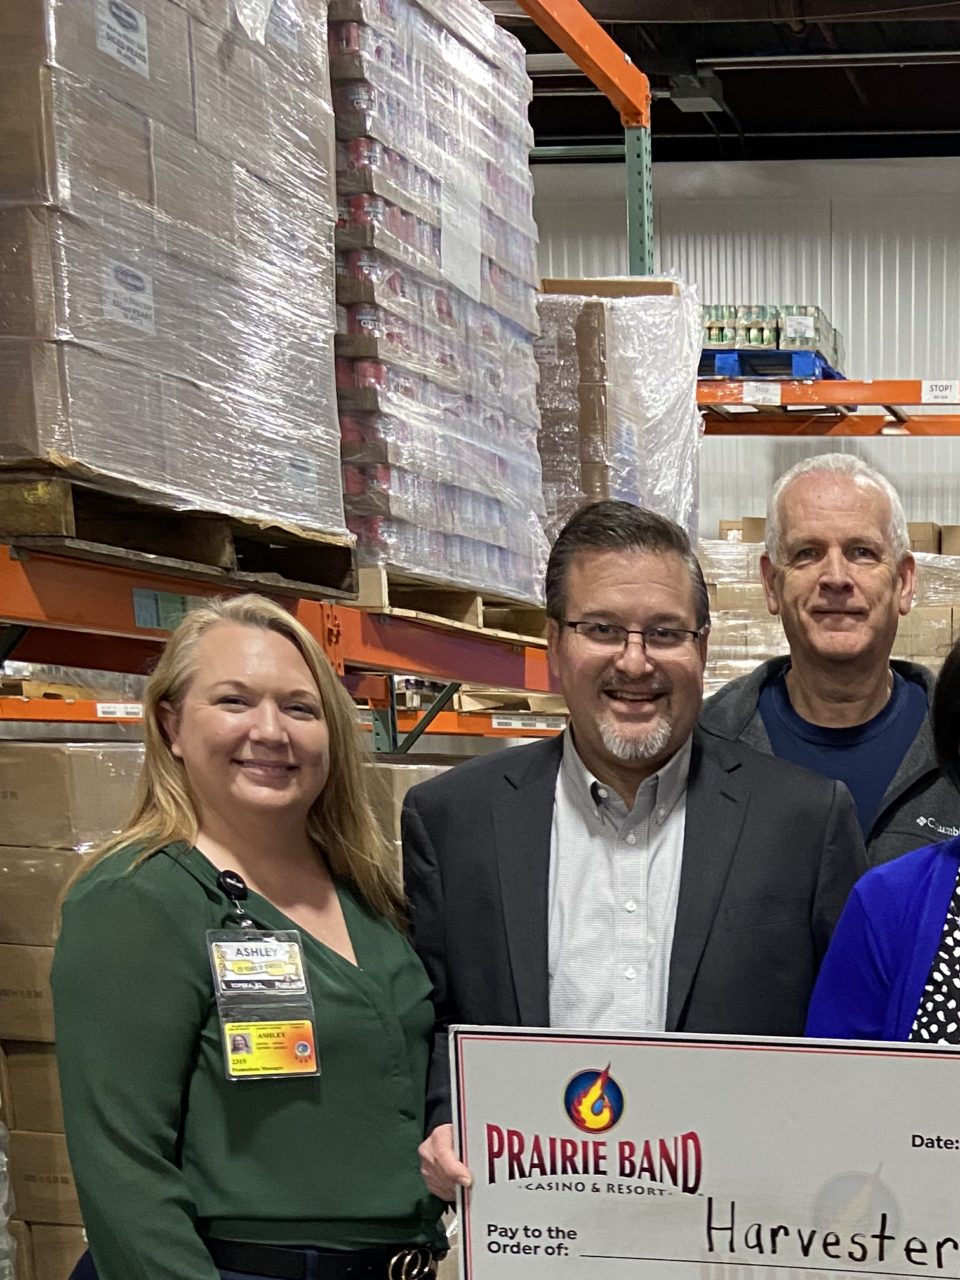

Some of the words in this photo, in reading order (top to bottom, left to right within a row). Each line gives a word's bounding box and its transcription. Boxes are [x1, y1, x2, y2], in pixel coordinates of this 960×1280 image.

[929, 384, 953, 393] STOP!
[235, 947, 278, 957] ASHLEY
[911, 1134, 960, 1150] Date:
[486, 1123, 607, 1185] PRAIRIE
[618, 1131, 703, 1195] BAND
[524, 1181, 586, 1193] CASINO
[590, 1182, 601, 1193] &
[606, 1184, 666, 1197] RESORT
[487, 1224, 519, 1241] Pay
[523, 1225, 543, 1239] to
[547, 1226, 578, 1241] the
[487, 1241, 540, 1255] Order
[544, 1242, 569, 1257] of:
